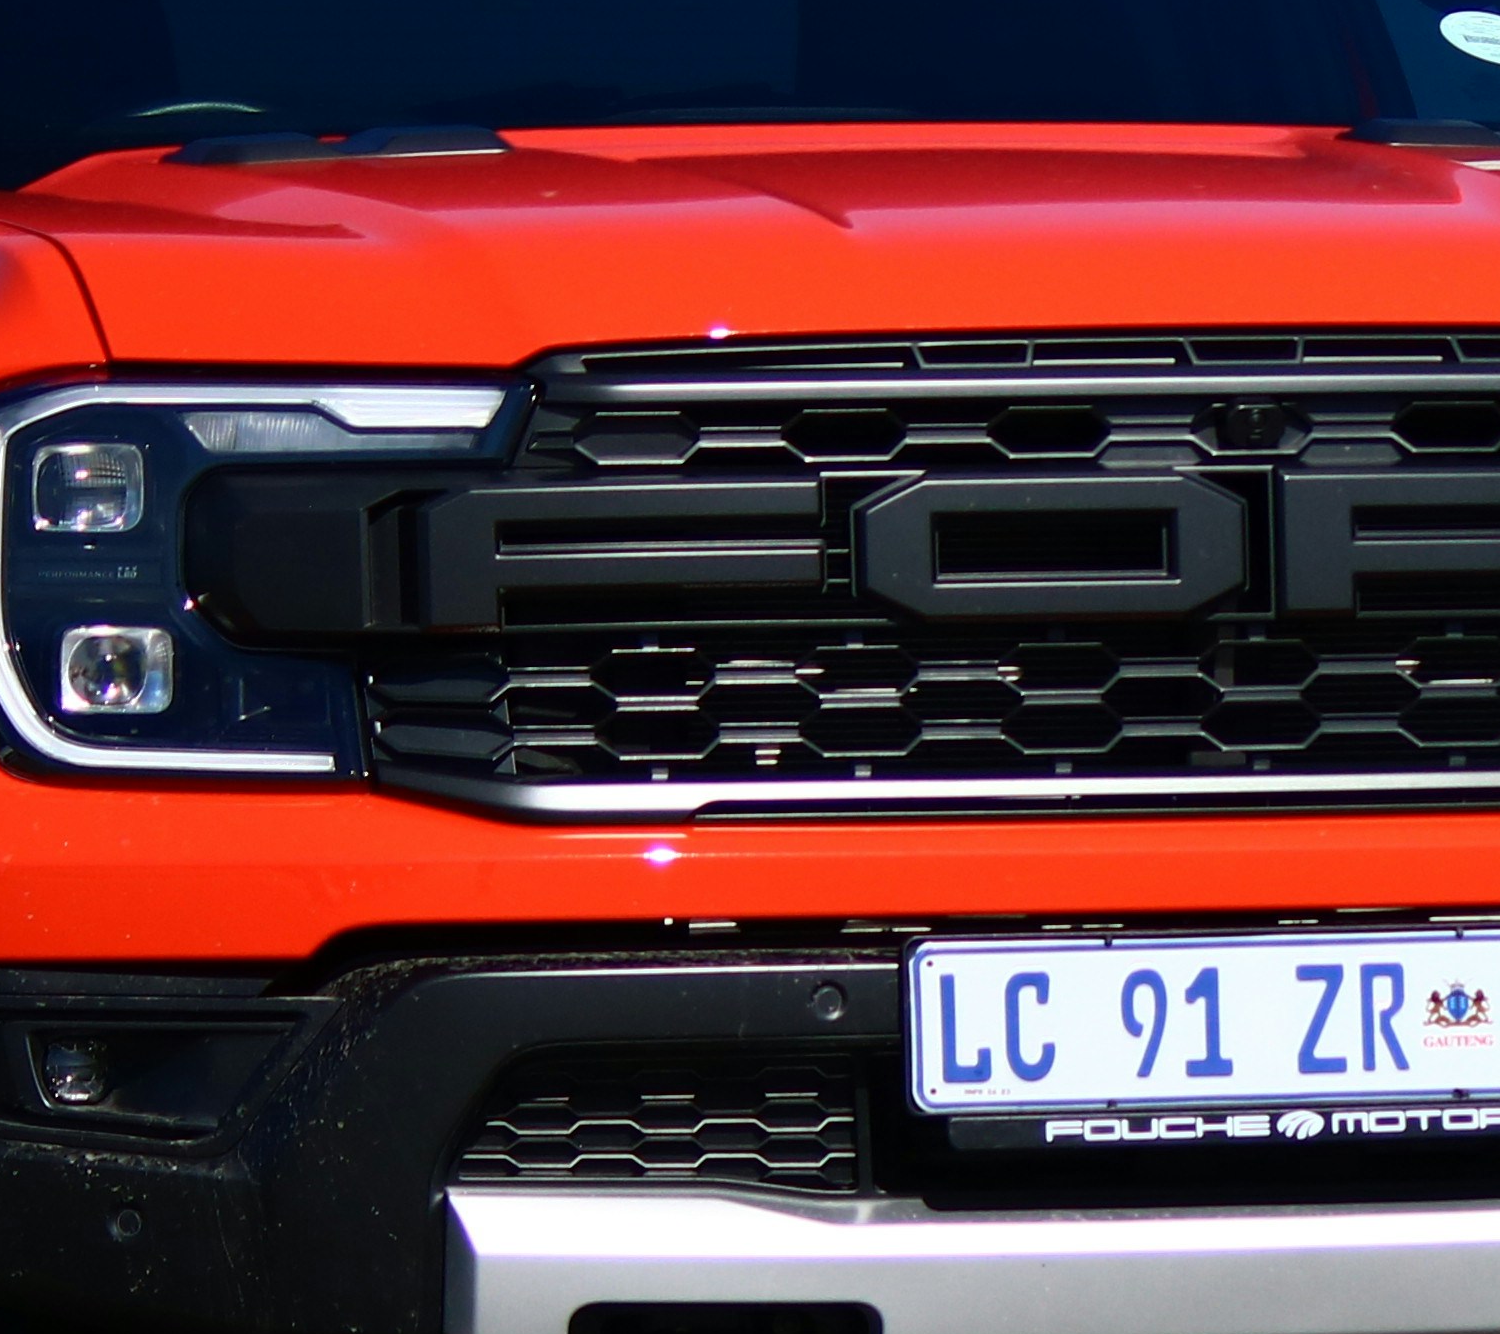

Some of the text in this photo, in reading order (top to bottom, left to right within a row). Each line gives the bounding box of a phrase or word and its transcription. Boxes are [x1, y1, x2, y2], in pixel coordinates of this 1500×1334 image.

[940, 971, 1057, 1084] LC
[1121, 967, 1234, 1079] 91
[1296, 962, 1410, 1075] ZR
[1422, 1034, 1495, 1049] GAUTENG
[1044, 1113, 1271, 1143] FOUCHE
